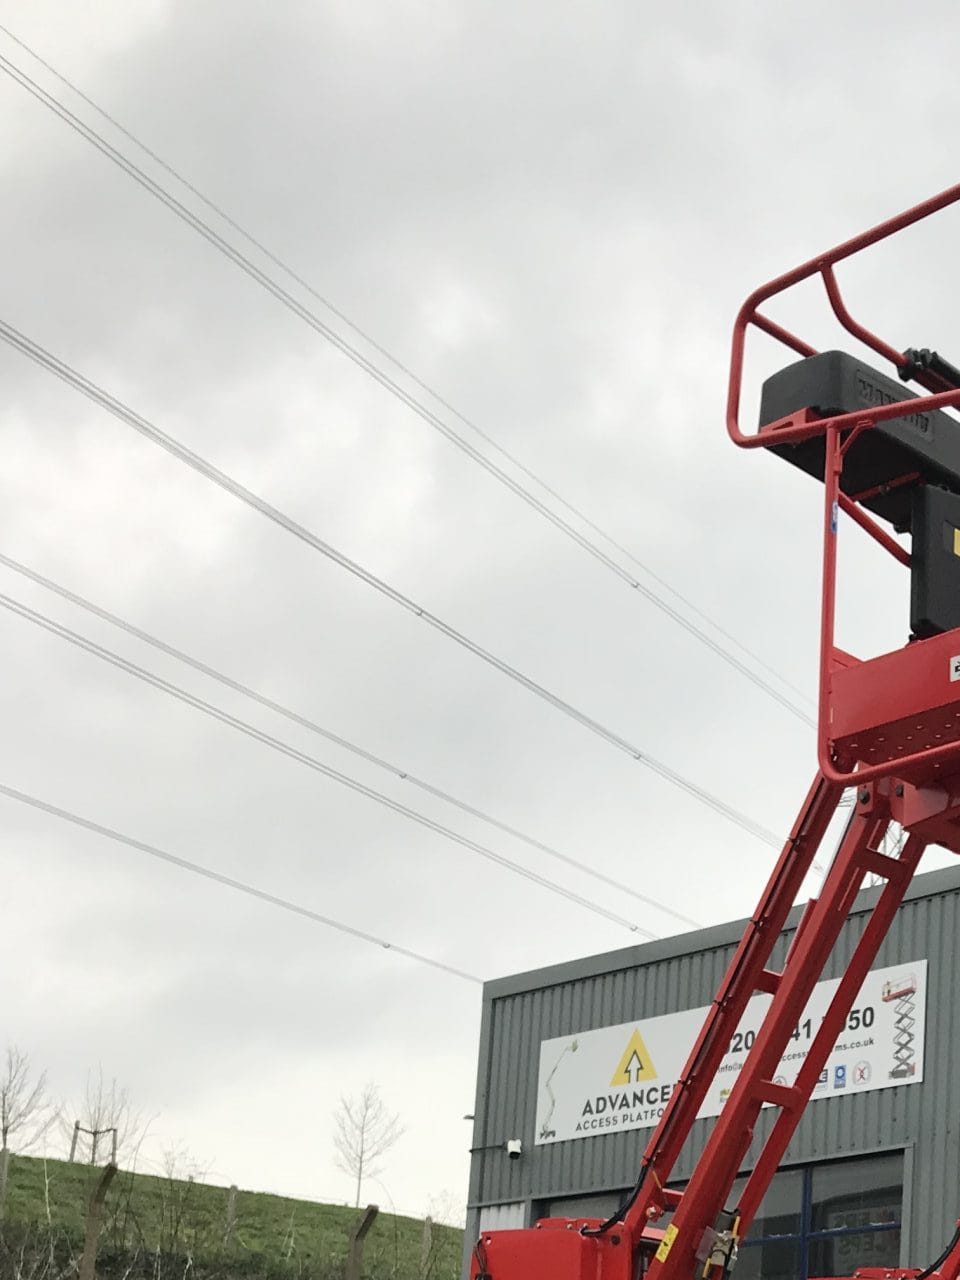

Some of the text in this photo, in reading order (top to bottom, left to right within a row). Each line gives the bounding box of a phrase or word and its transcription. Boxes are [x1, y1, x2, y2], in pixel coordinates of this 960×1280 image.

[724, 1030, 756, 1055] 20
[582, 1084, 680, 1116] ADVANCE
[576, 1116, 618, 1131] ACCESS
